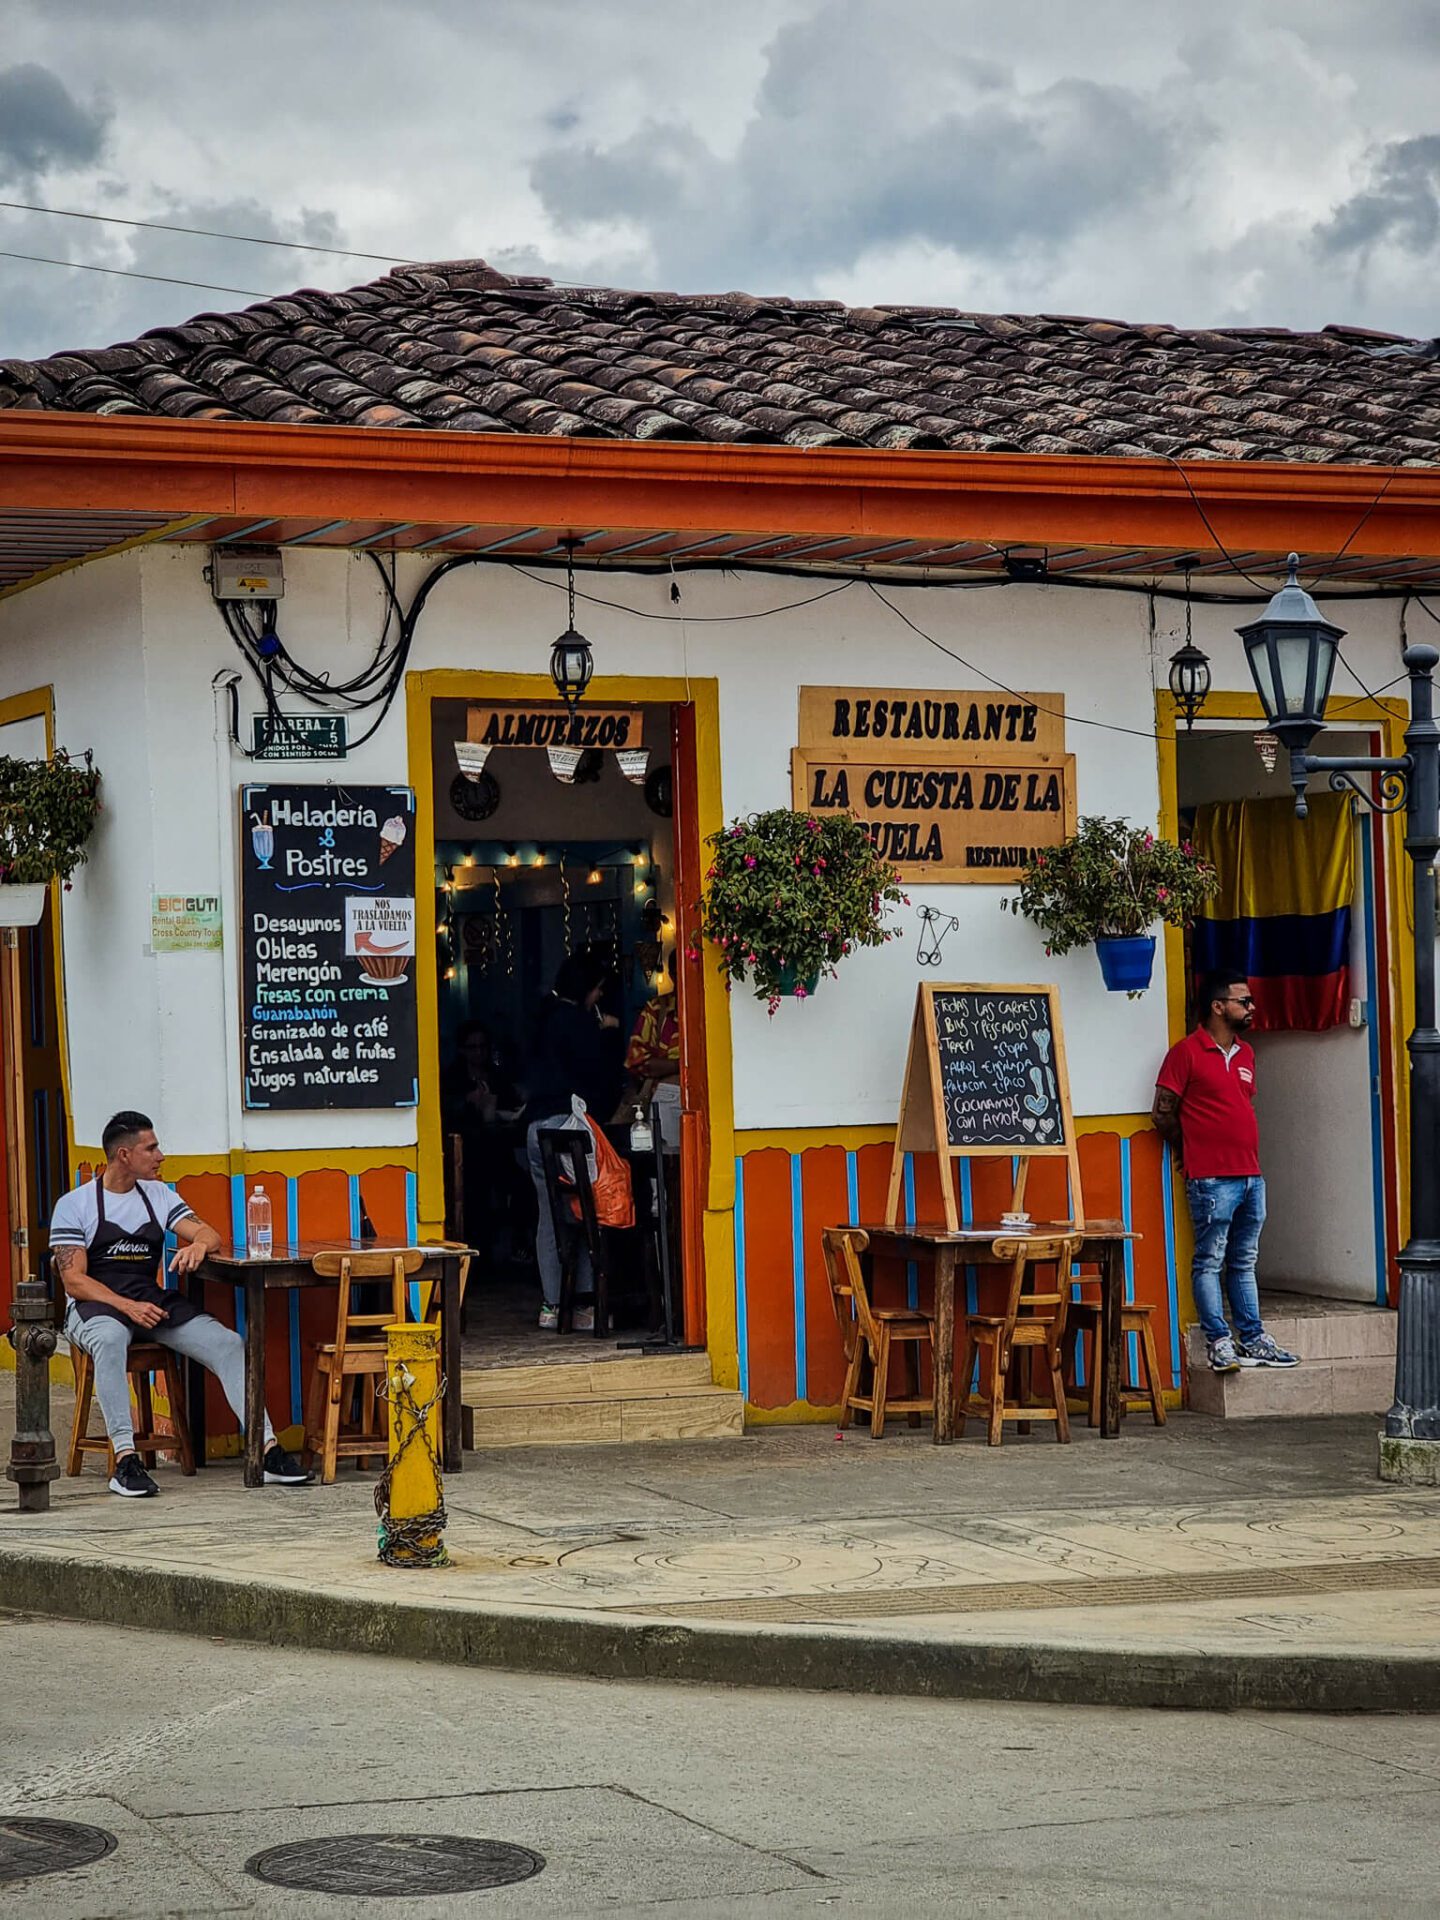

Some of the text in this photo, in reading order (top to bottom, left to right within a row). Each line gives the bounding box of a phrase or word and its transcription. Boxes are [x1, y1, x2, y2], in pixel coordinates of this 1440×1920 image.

[330, 719, 337, 731] 7
[481, 713, 631, 747] ALMUERZOS
[832, 699, 1038, 742] RESTAURANTE
[330, 731, 338, 744] 5
[810, 769, 1061, 812] LA CUESTA DE LA
[853, 822, 944, 861] UELA
[285, 849, 368, 877] Postres
[158, 897, 218, 912] BICIGUTI
[352, 910, 412, 920] TRASLADAMOS
[374, 899, 391, 909] NOS
[152, 928, 172, 937] Cross
[253, 913, 343, 936] Desayunos
[356, 920, 407, 931] A LA VUELTA
[255, 936, 318, 960] Obleas
[256, 960, 342, 987] Merengón
[304, 987, 336, 1003] con
[339, 986, 389, 1001] crema
[251, 1015, 389, 1041] Granizado de café
[250, 1041, 397, 1066] Ensalada de frutas
[249, 1065, 380, 1093] Jugos naturales
